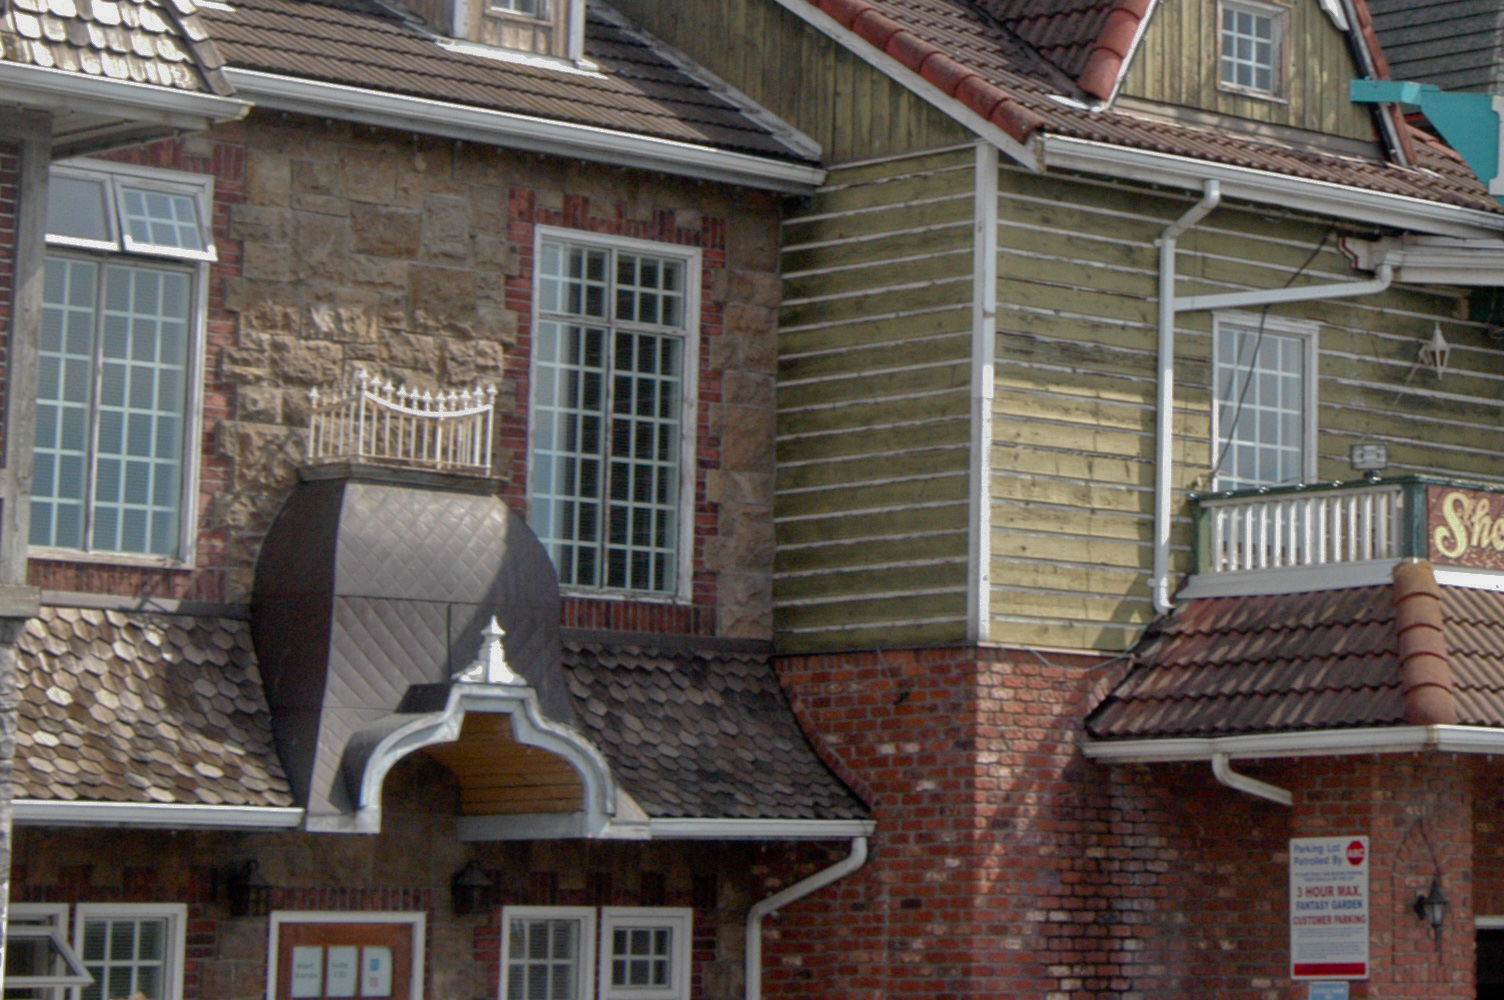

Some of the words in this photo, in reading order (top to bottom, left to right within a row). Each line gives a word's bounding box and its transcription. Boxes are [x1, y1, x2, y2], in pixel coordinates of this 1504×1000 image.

[1294, 844, 1324, 855] Parking
[1327, 843, 1341, 853] Lot
[1332, 854, 1344, 867] By
[1305, 886, 1335, 898] HOUR
[1296, 901, 1329, 911] FANTASY
[1332, 900, 1364, 910] GARDEN
[1293, 915, 1332, 926] CUSTOMER
[1334, 914, 1367, 925] PARKING
